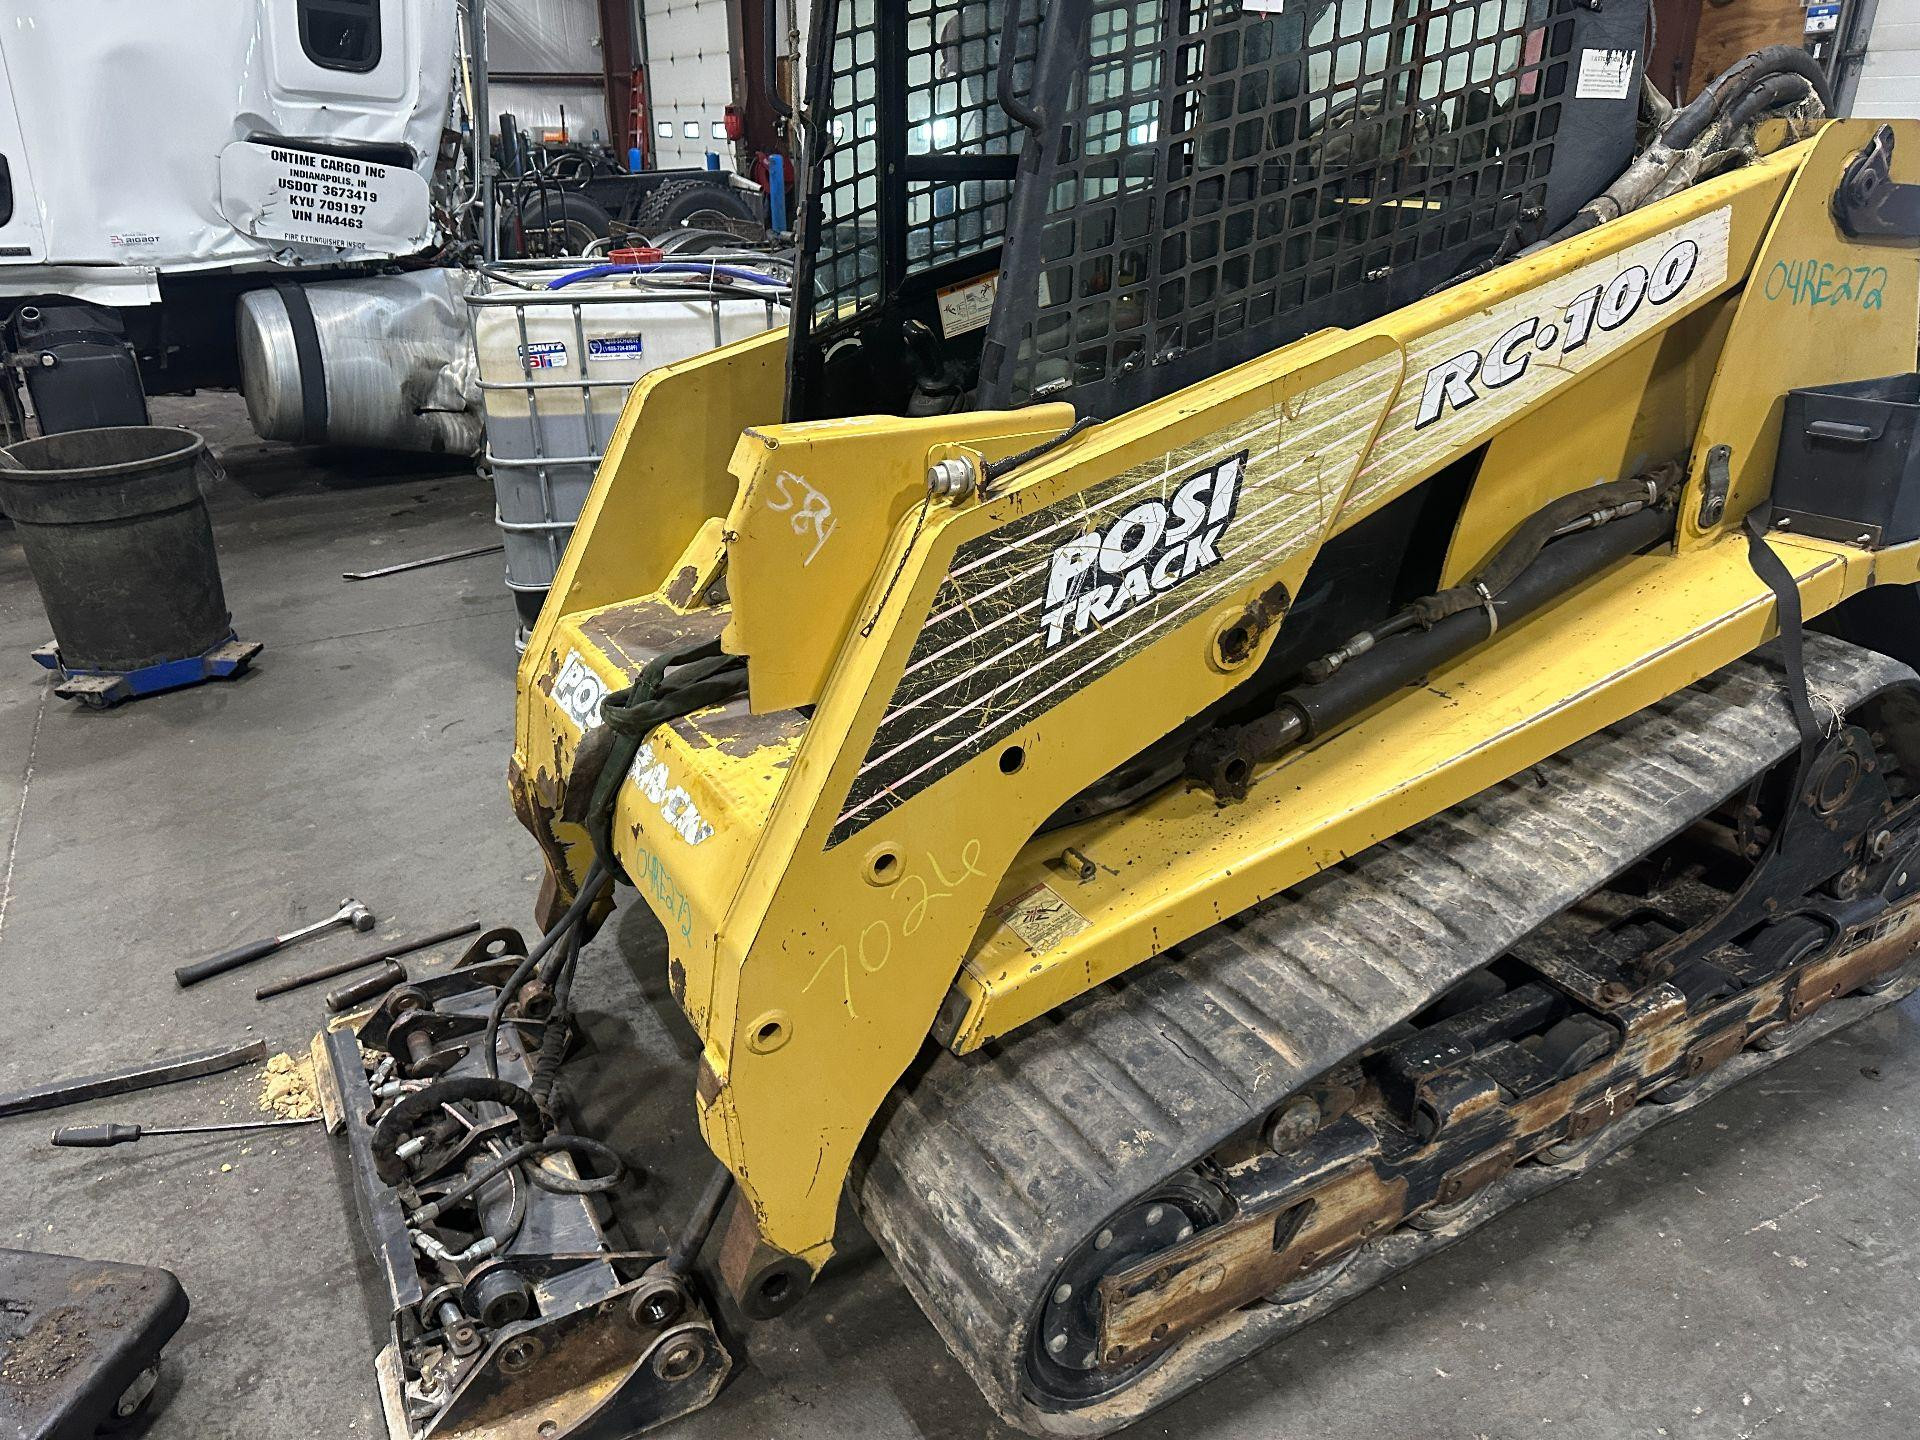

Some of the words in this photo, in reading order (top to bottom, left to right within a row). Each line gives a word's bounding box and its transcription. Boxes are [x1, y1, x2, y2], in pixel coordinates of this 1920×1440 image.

[271, 150, 316, 168] ONTIME
[320, 158, 360, 174] CARGO
[365, 166, 386, 179] INC
[278, 178, 318, 194] USDOT
[322, 185, 378, 203] 3673419
[357, 179, 367, 188] IN
[289, 195, 315, 207] KYU
[319, 199, 366, 215] 709197
[291, 209, 312, 222] VIN
[316, 213, 363, 229] HA4463
[284, 232, 299, 241] FIRE
[300, 234, 345, 247] EXTINGUISHER
[346, 240, 366, 250] INSIDE
[1765, 259, 1887, 310] 04RE272
[1044, 452, 1245, 611] POSI
[1040, 524, 1224, 649] TRACK
[801, 838, 988, 1018] 7026
